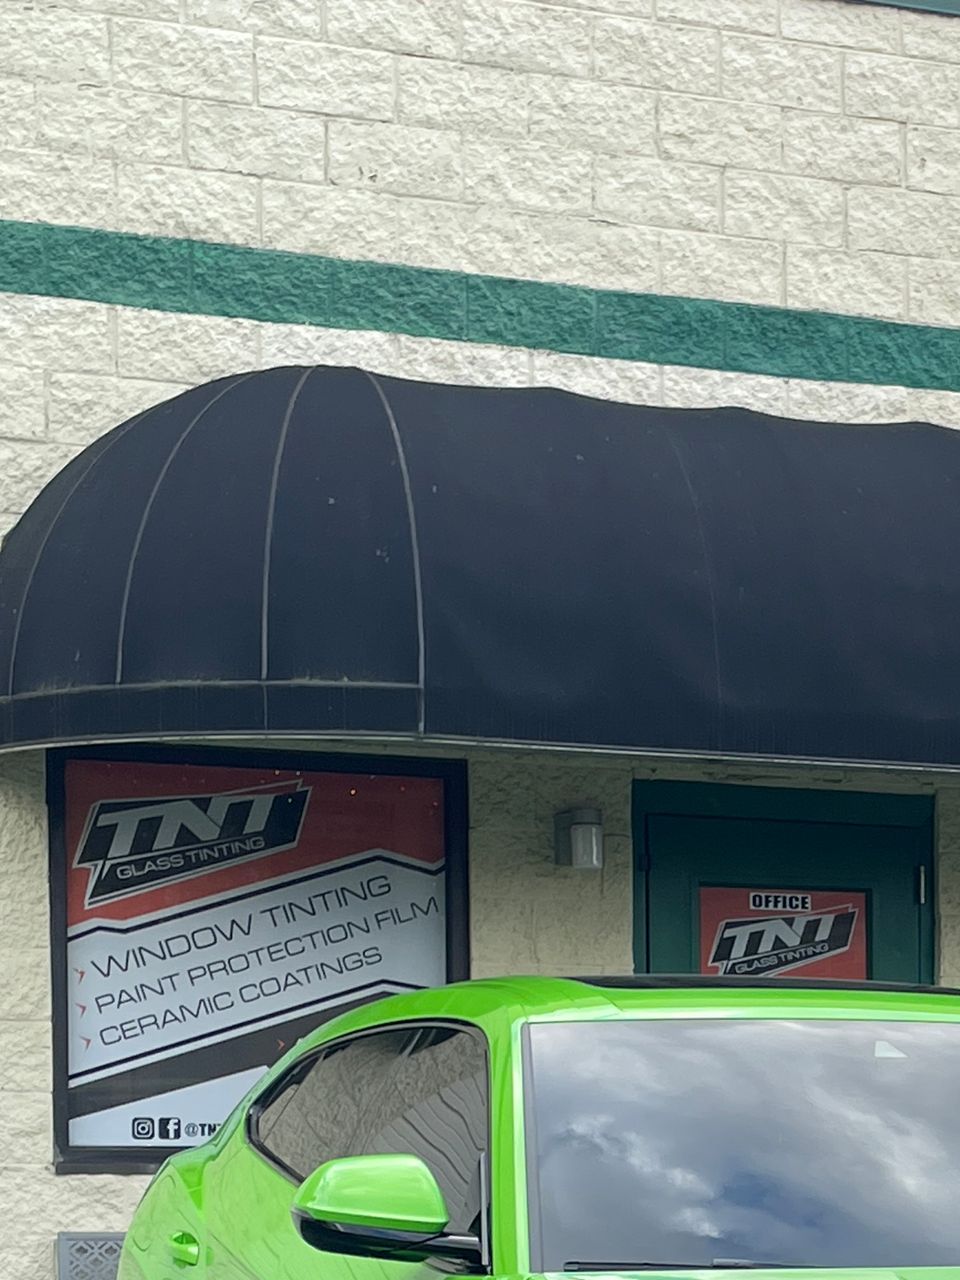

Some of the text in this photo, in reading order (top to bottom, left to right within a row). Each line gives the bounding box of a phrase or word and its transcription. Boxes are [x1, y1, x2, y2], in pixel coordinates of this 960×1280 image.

[96, 794, 275, 858] TNT
[116, 836, 266, 880] GLASS TINTING
[751, 894, 809, 910] OFFICE
[91, 874, 392, 979] WINDOW TINTING
[722, 914, 837, 960] TNT
[95, 896, 439, 1015] PAINT PROTECTION FILM
[734, 942, 829, 974] GLASS TINTING
[99, 946, 383, 1047] CERAMIC COATINGS
[184, 1122, 220, 1138] @TN
